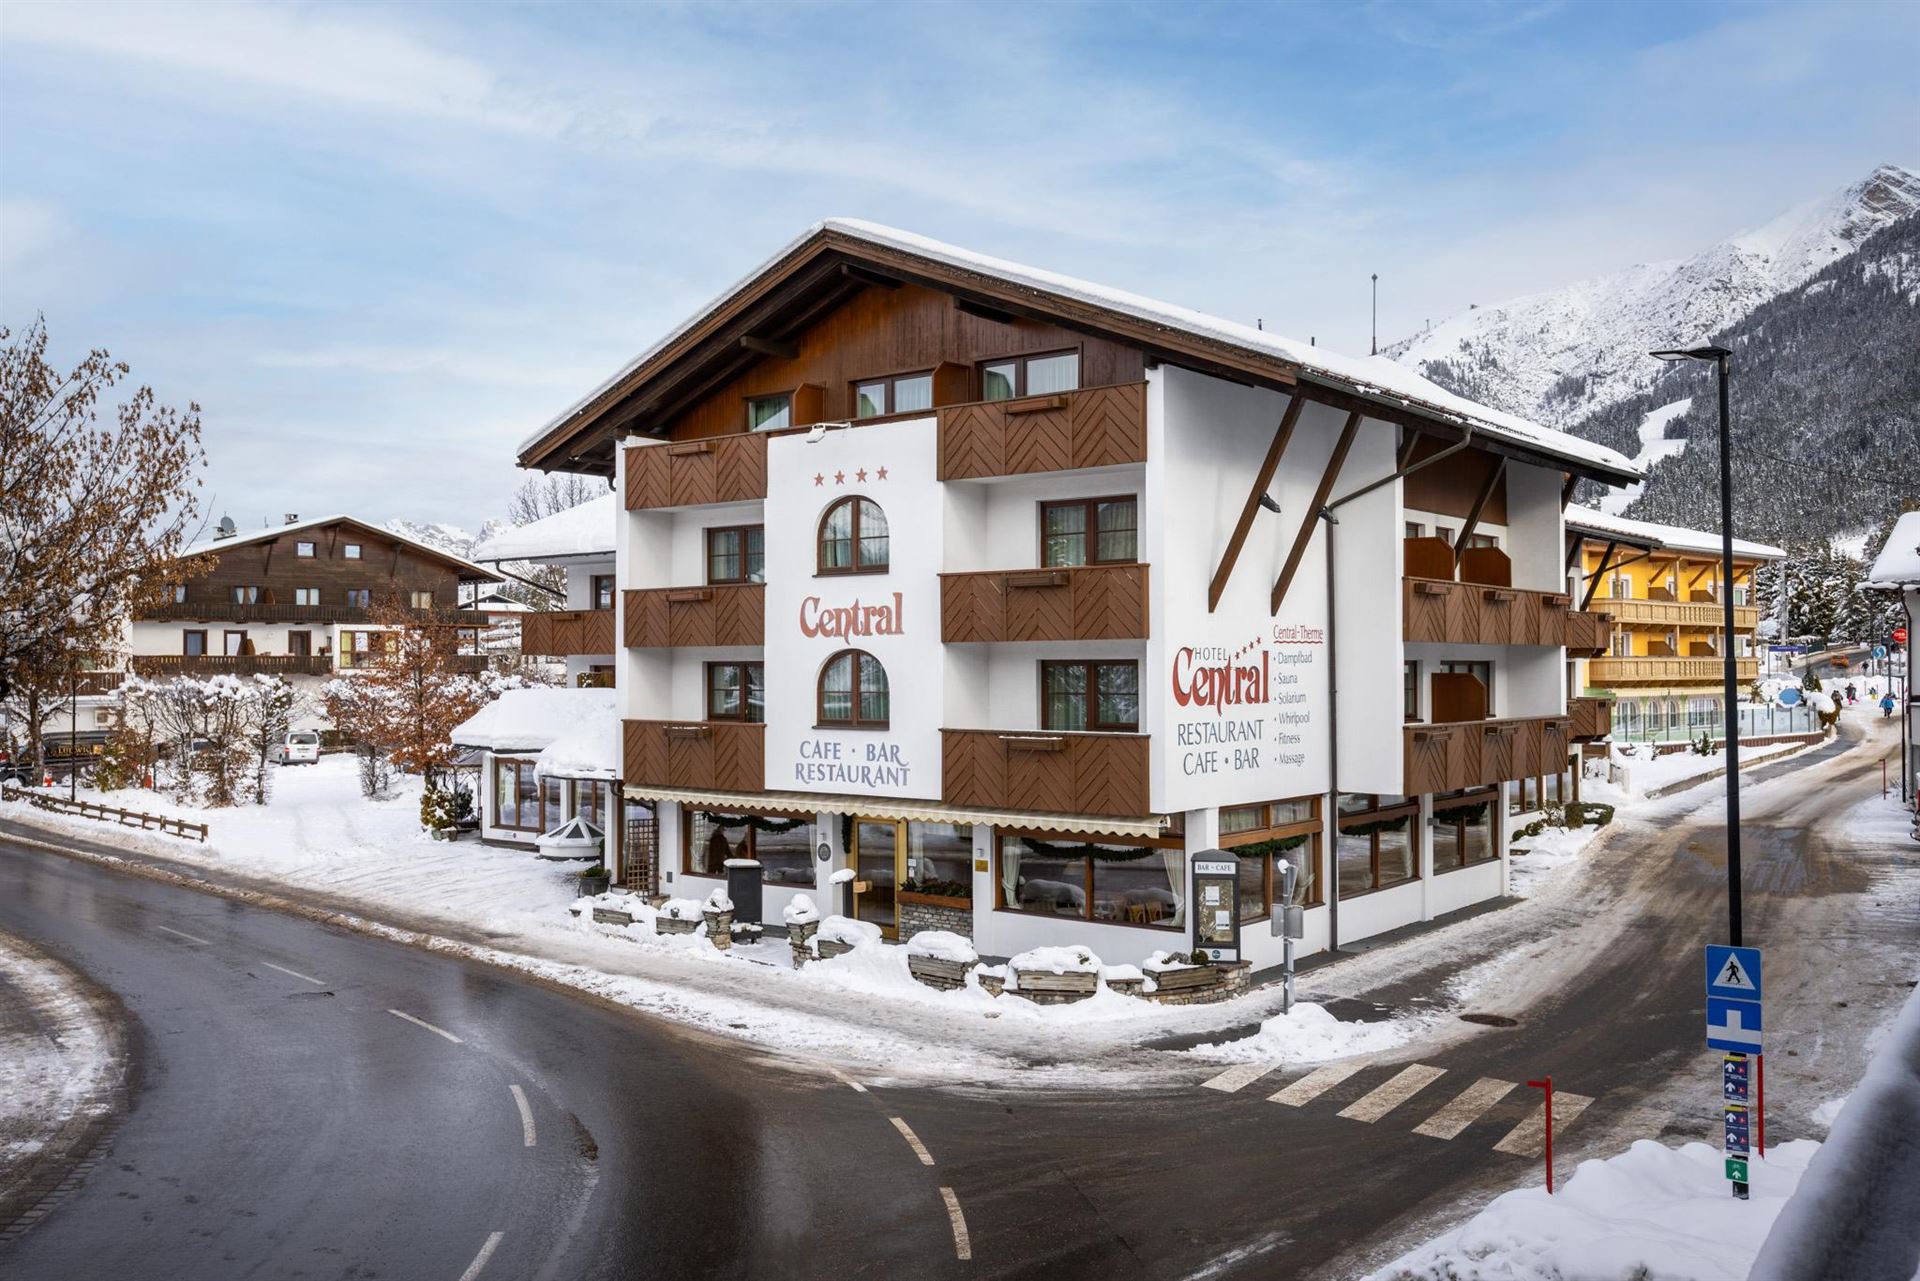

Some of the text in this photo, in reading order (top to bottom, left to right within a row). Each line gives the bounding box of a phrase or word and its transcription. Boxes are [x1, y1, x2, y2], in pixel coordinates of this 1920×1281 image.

[799, 592, 905, 645] Central
[1273, 624, 1323, 640] Central-Therme
[1194, 647, 1227, 661] HOTEL
[1278, 650, 1312, 667] Dampfbad
[1172, 646, 1270, 717] Central
[1278, 672, 1298, 685] Sauna
[1278, 691, 1307, 705] Solarium
[1278, 710, 1311, 727] Whirlpool
[1177, 719, 1264, 747] RESTAURANT
[1278, 732, 1301, 745] Fitness
[799, 740, 909, 767] CAFE BAR
[1183, 747, 1260, 776] CAFE BAR
[1279, 753, 1305, 767] Massage
[795, 762, 911, 788] RESTAURANT
[1197, 863, 1232, 871] BAR CAFE
